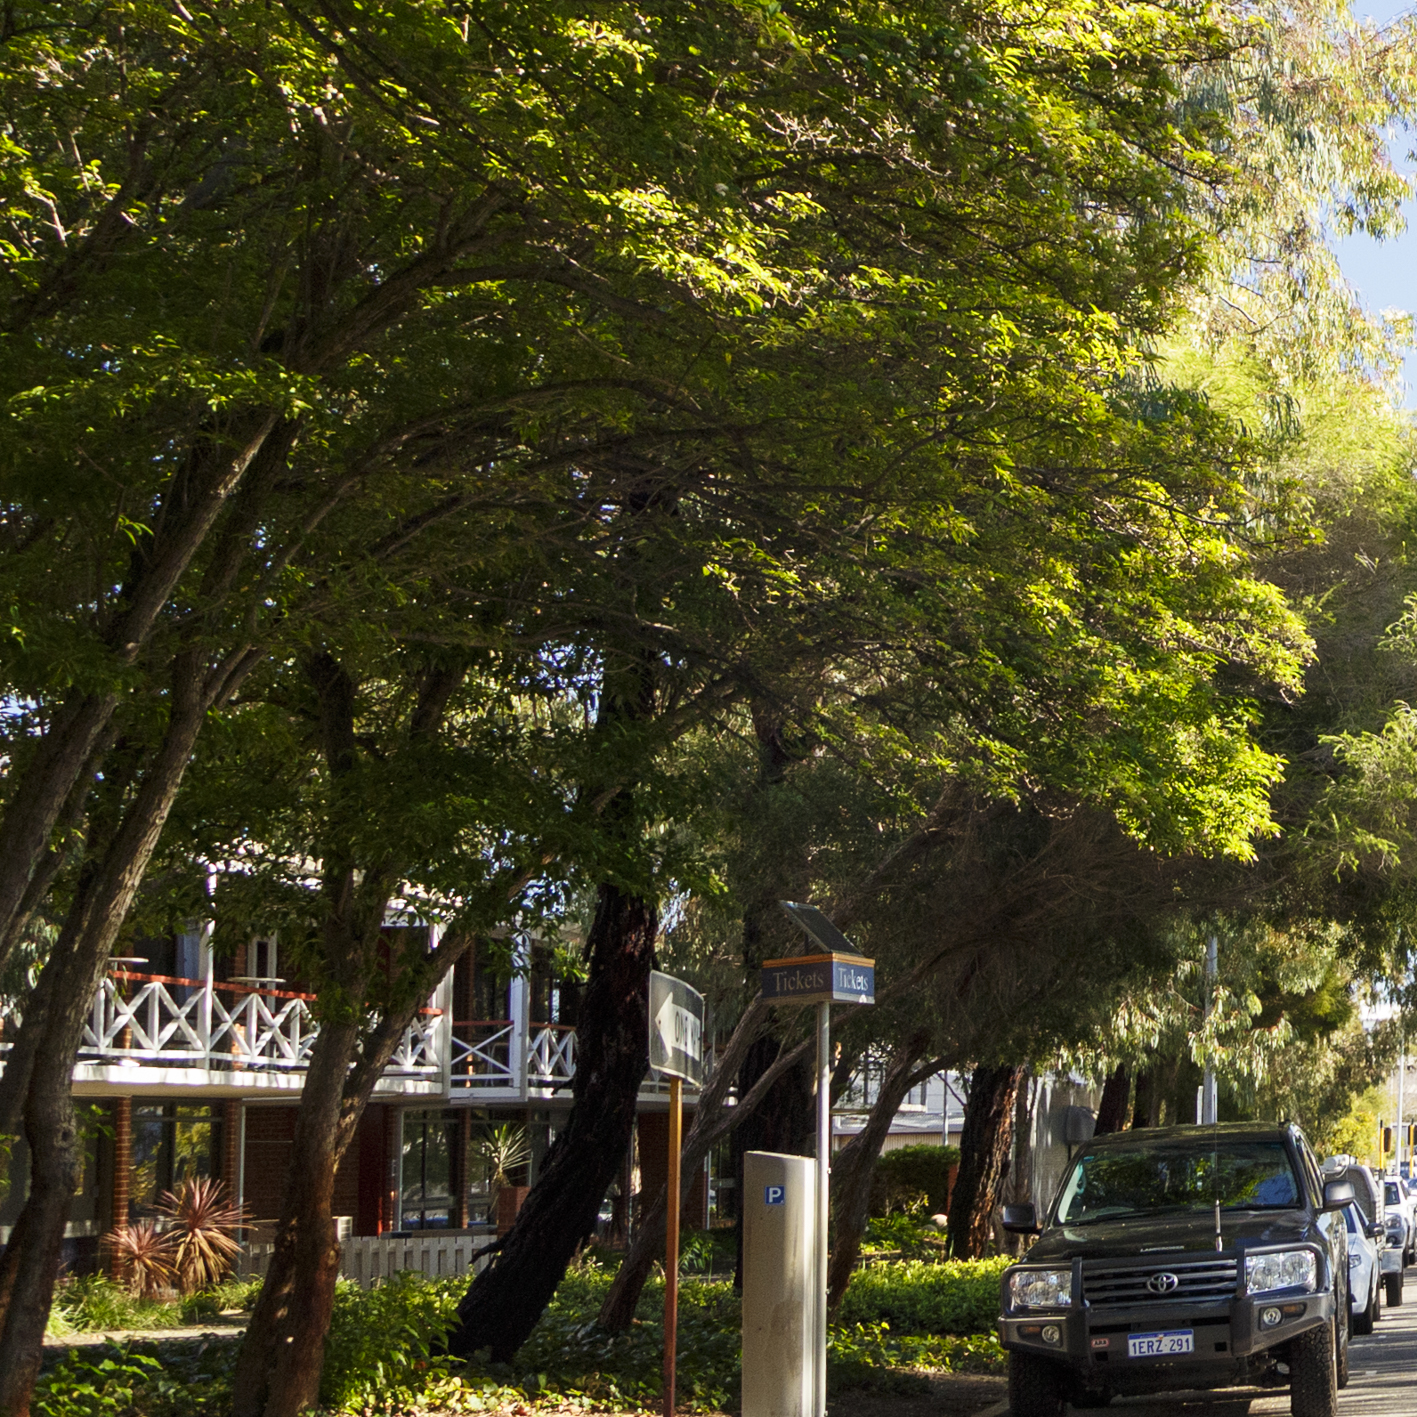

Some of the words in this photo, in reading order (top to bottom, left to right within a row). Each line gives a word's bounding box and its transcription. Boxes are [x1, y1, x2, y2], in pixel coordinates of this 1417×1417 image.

[772, 970, 824, 992] Tickets
[838, 967, 869, 991] Tickets
[769, 1187, 782, 1203] P
